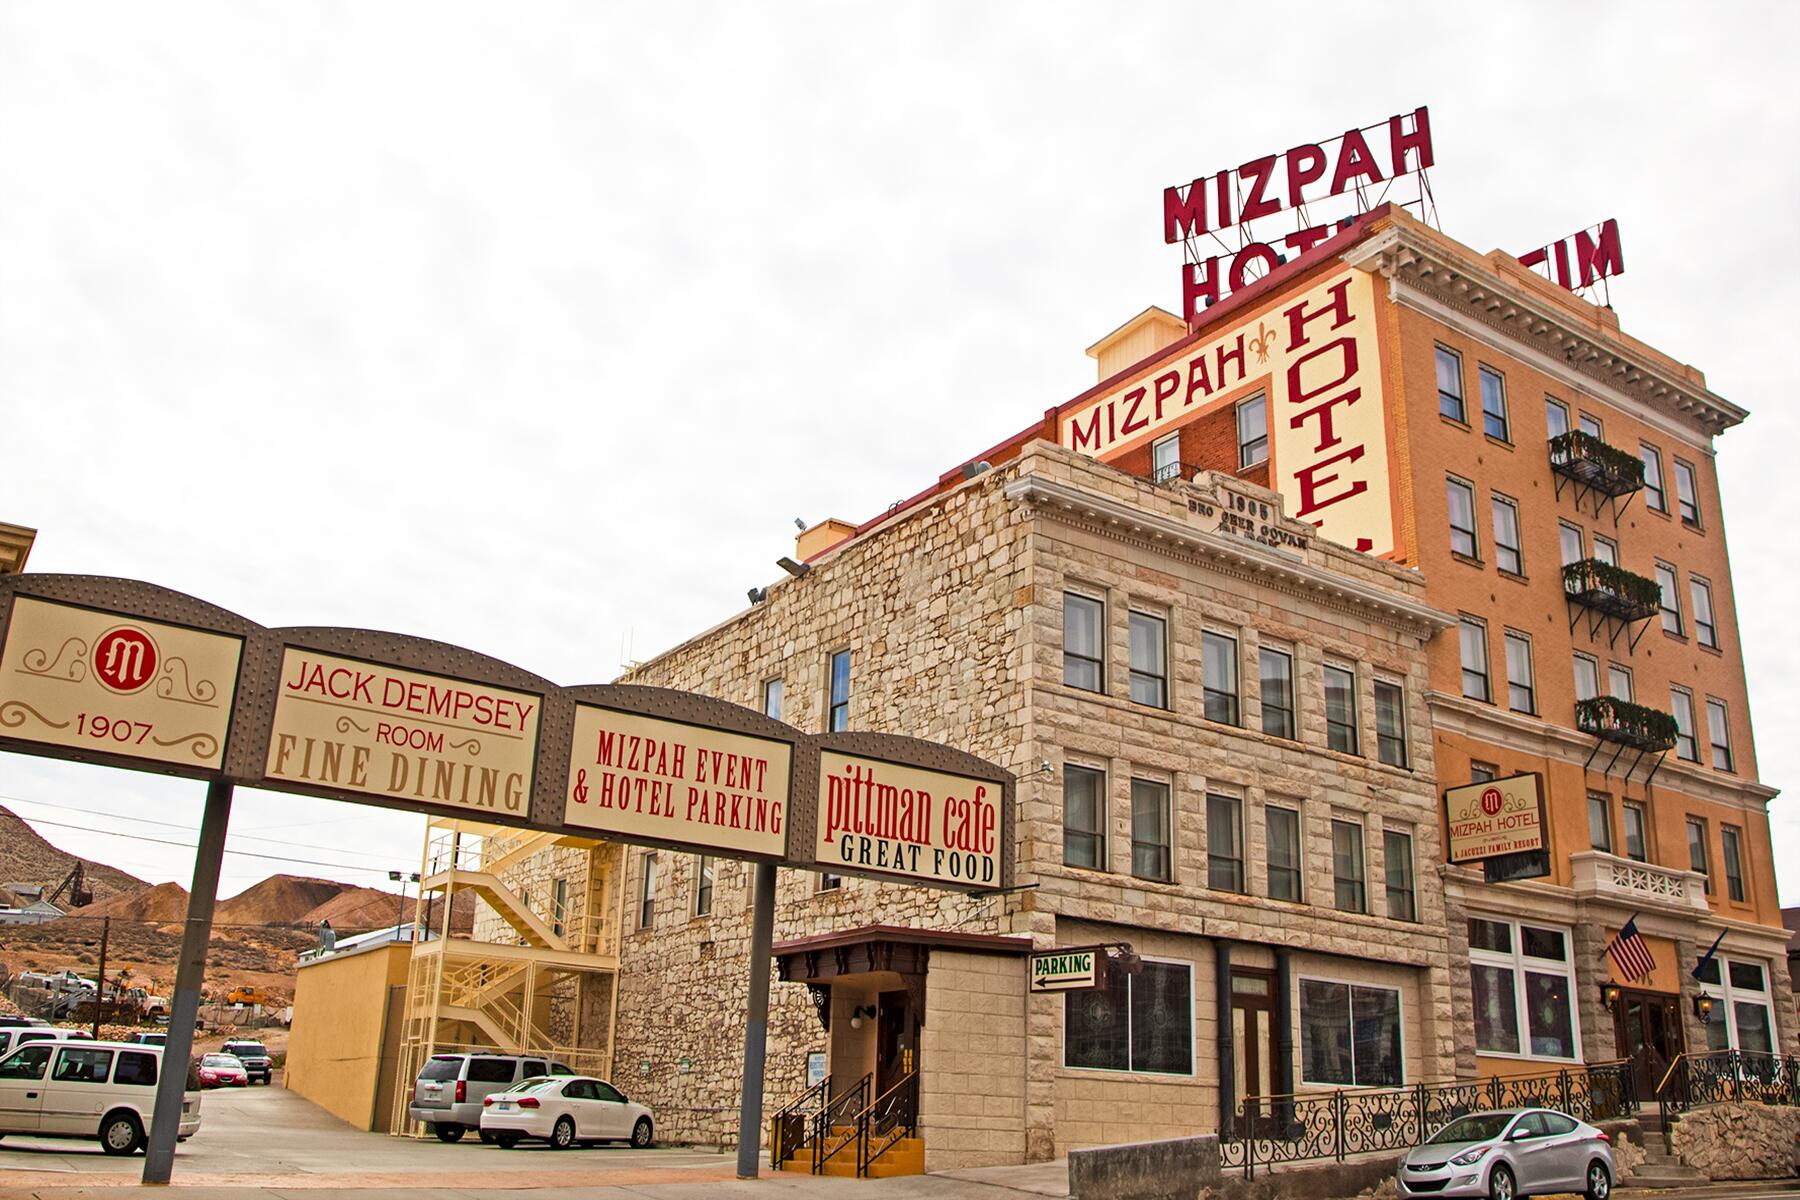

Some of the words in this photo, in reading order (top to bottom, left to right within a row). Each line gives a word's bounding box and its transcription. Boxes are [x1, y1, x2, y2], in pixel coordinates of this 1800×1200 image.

[1164, 106, 1435, 244] MIZPAH
[1072, 333, 1246, 452] MIZPAH
[1283, 277, 1373, 552] HOTE
[1227, 491, 1268, 520] 1905
[1260, 525, 1307, 549] GOVAN
[287, 661, 373, 703] JACK
[381, 677, 533, 732] DEMPSEY
[76, 713, 153, 745] 1907
[376, 722, 444, 753] ROOM
[272, 733, 370, 787] FINE
[387, 752, 524, 811] DINING
[597, 730, 685, 779] MIZPAH
[695, 748, 768, 793] EVENT
[573, 768, 589, 804] &
[600, 772, 675, 819] HOTEL
[686, 786, 783, 835] PARKING
[823, 764, 932, 846] pittman
[943, 785, 996, 854] cafe
[1450, 820, 1492, 838] MIZPAH
[1498, 813, 1539, 831] HOTEL
[840, 834, 921, 873] GREAT
[933, 848, 995, 882] FOOD
[1488, 841, 1511, 853] FAMILY
[1514, 837, 1539, 849] RESORT
[1035, 954, 1091, 976] PARKING
